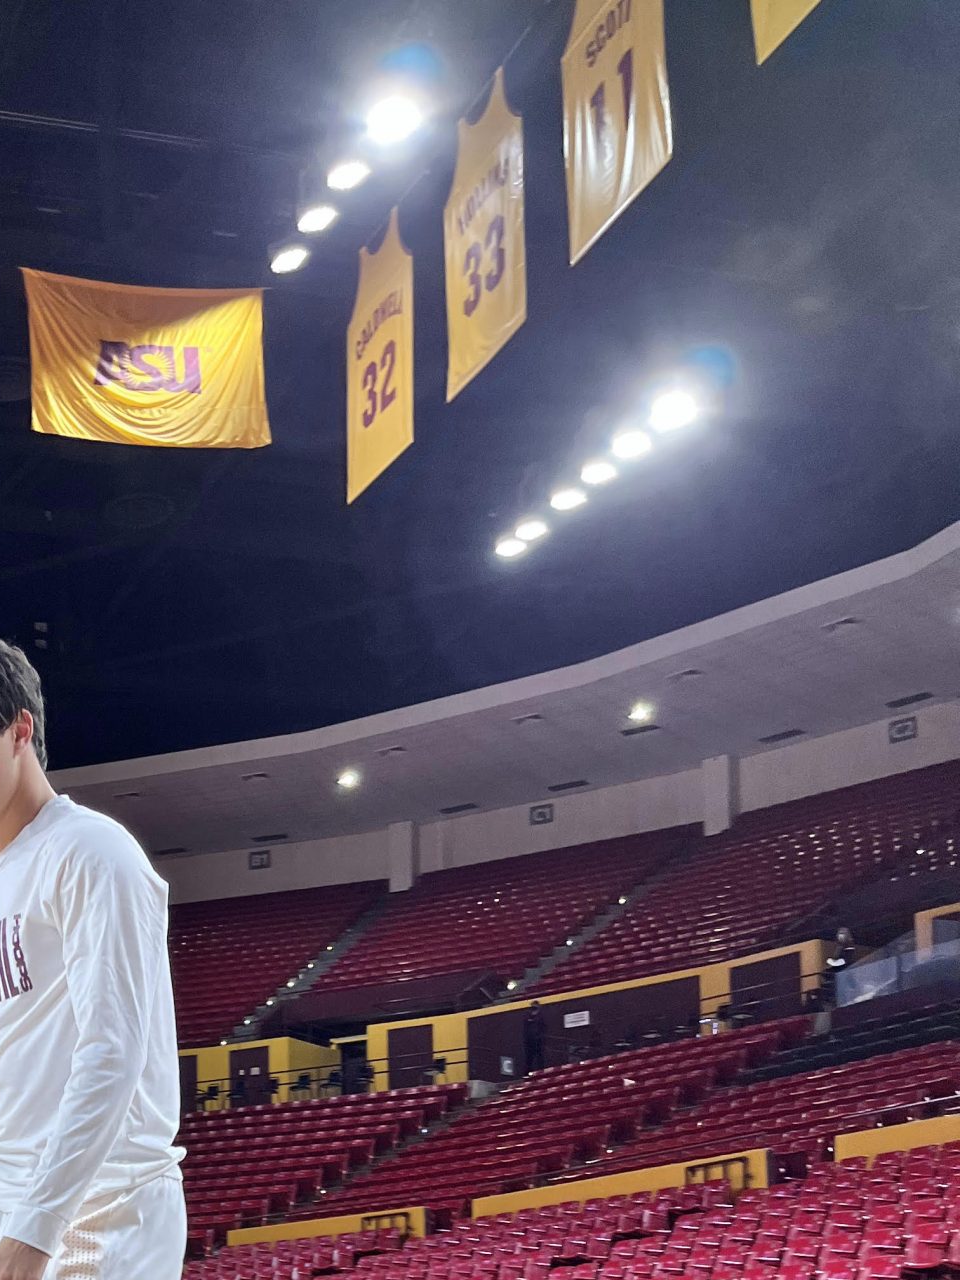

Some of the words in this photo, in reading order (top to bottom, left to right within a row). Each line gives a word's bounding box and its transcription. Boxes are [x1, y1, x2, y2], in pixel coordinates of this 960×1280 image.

[590, 47, 634, 140] 11
[463, 214, 505, 318] 33
[93, 339, 202, 395] ASU
[362, 339, 396, 428] 32
